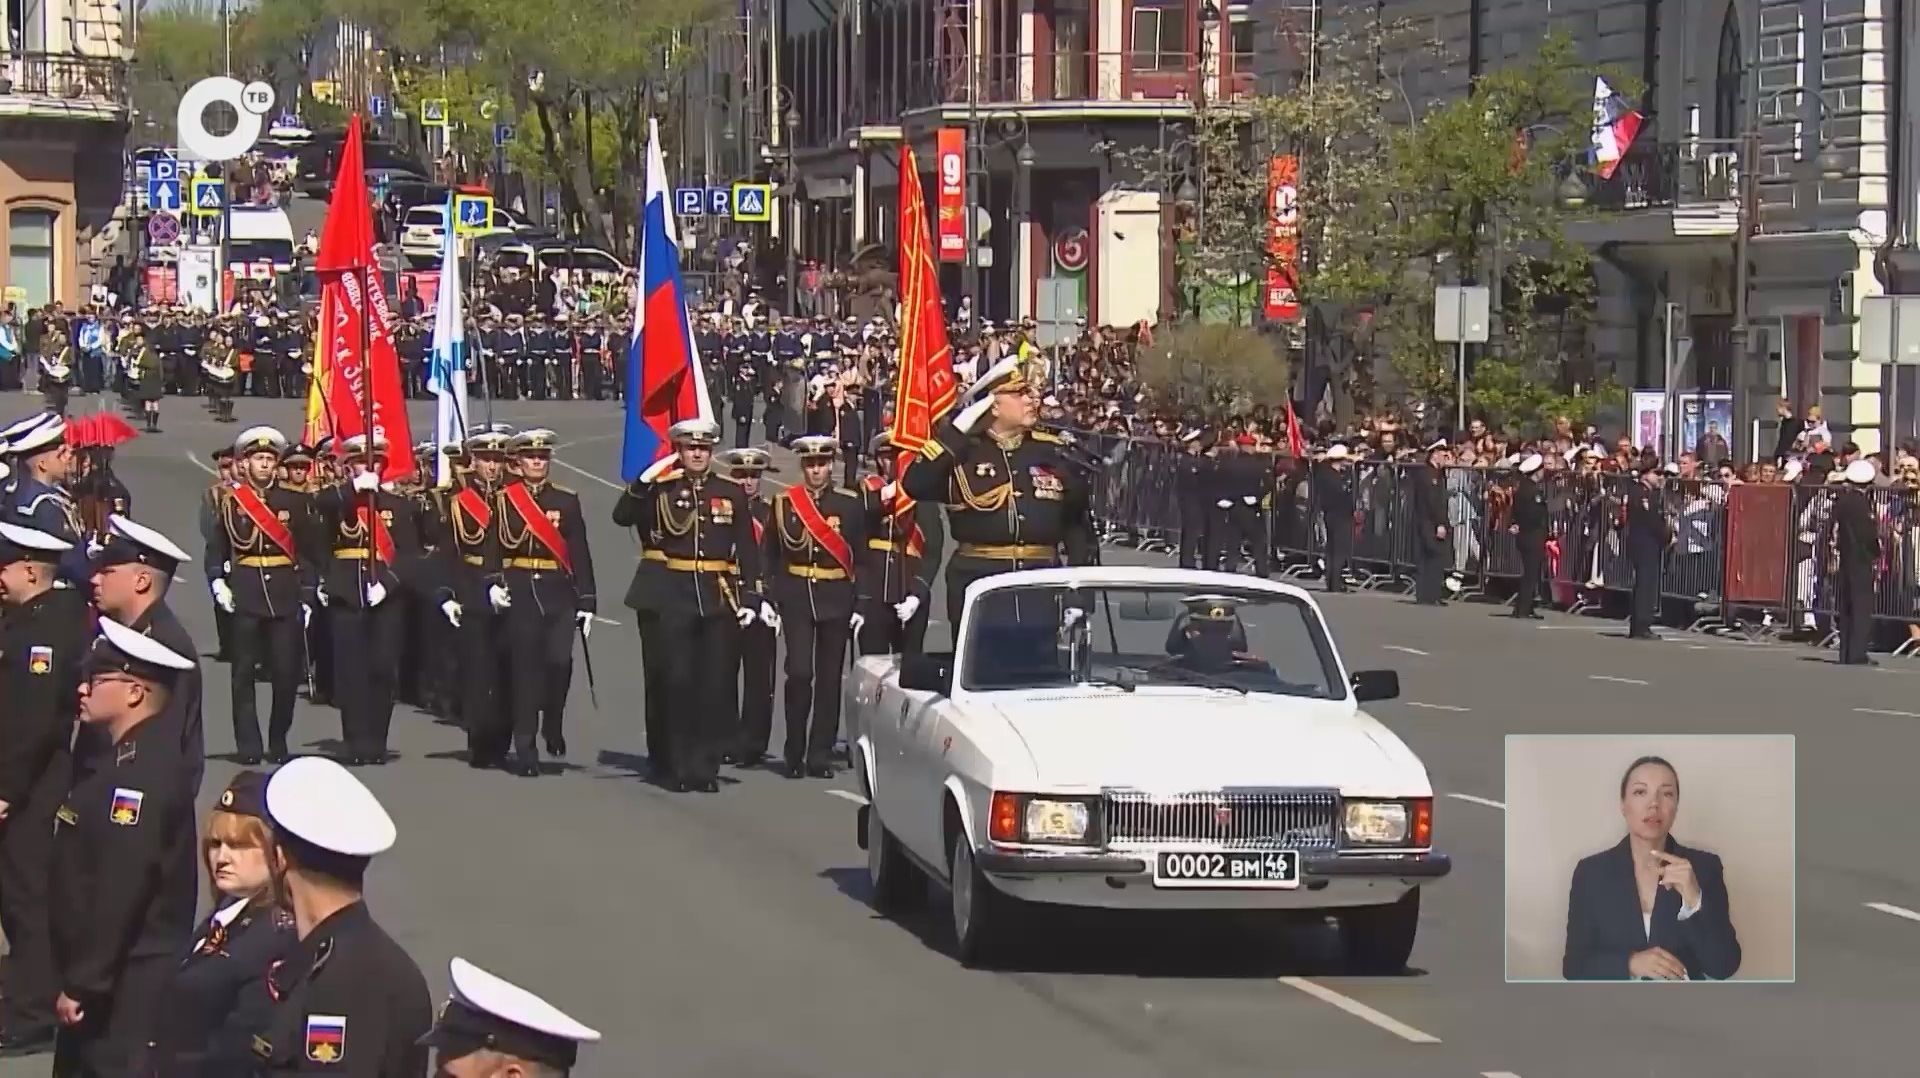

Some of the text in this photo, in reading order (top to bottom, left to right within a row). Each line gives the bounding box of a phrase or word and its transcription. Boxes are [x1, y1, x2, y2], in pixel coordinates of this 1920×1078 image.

[157, 163, 173, 178] P
[943, 153, 961, 185] 9
[684, 192, 698, 213] P
[1166, 854, 1288, 877] 0002 ВМ 46
